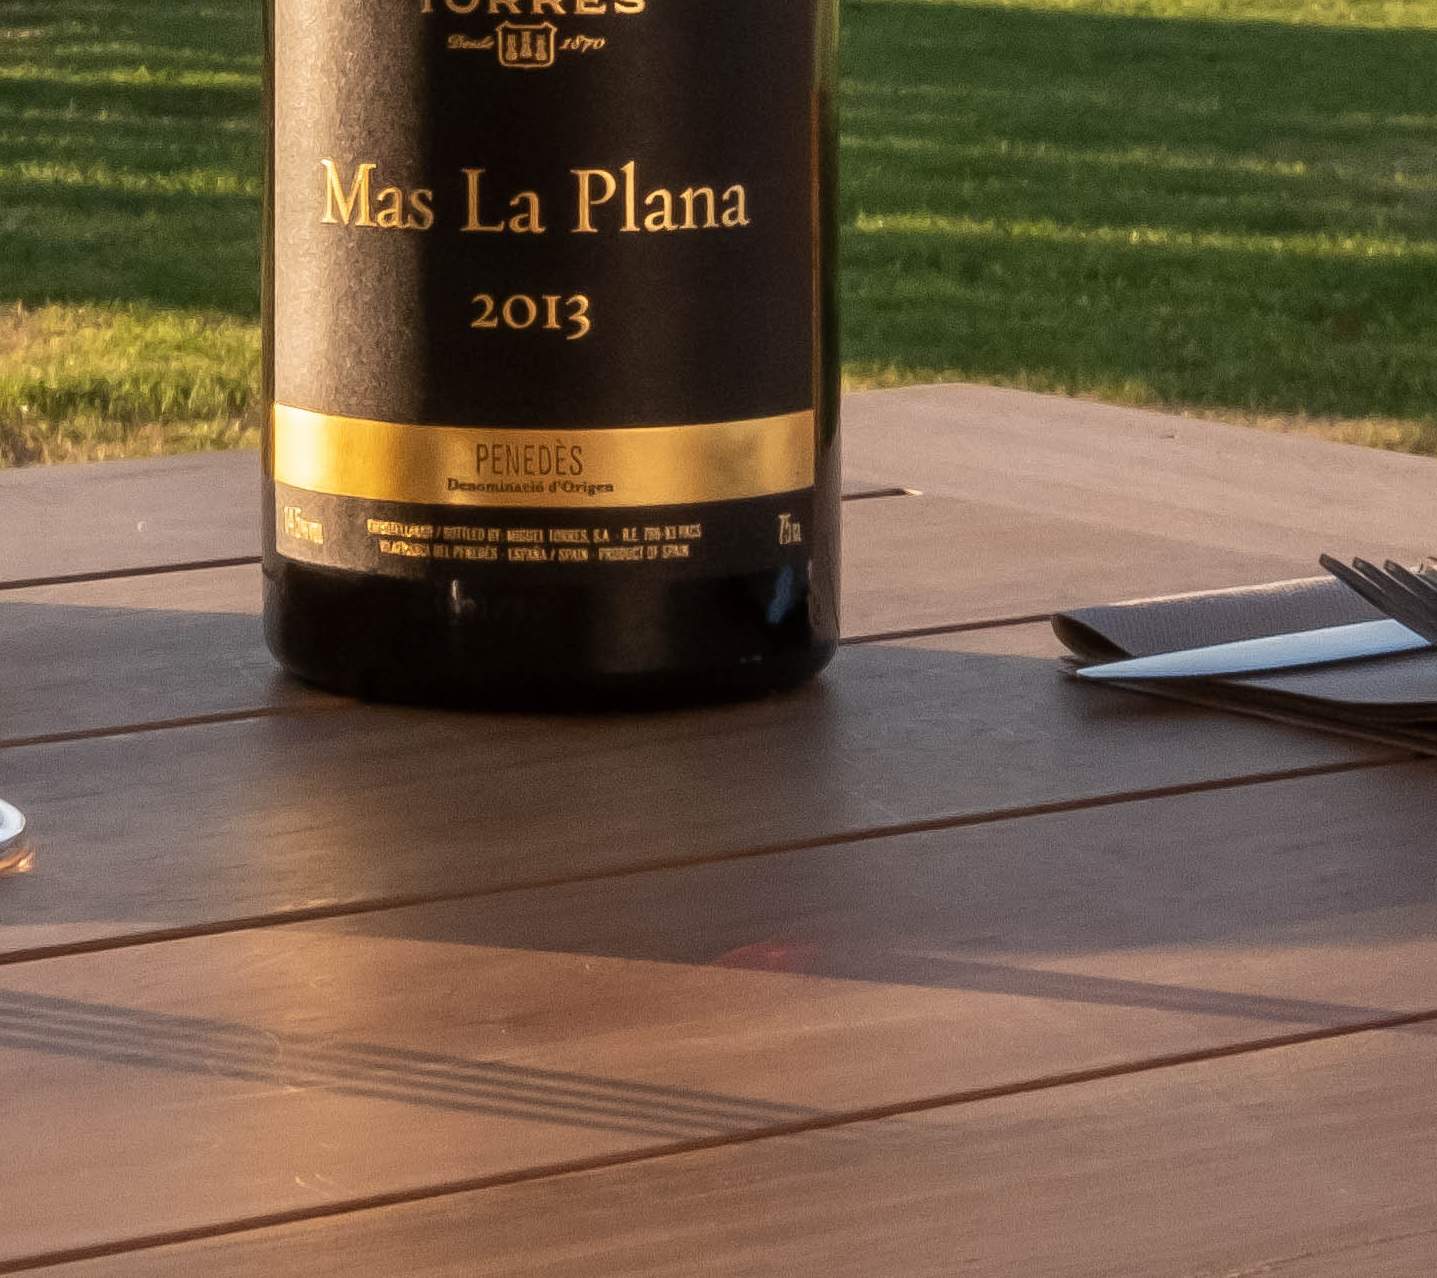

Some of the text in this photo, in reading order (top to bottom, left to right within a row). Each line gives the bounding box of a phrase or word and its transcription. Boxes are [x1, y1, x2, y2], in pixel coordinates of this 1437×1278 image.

[559, 35, 606, 52] 1870
[320, 157, 750, 233] Mas La Plana
[471, 293, 591, 340] 2013
[476, 439, 583, 476] PENEDÈS
